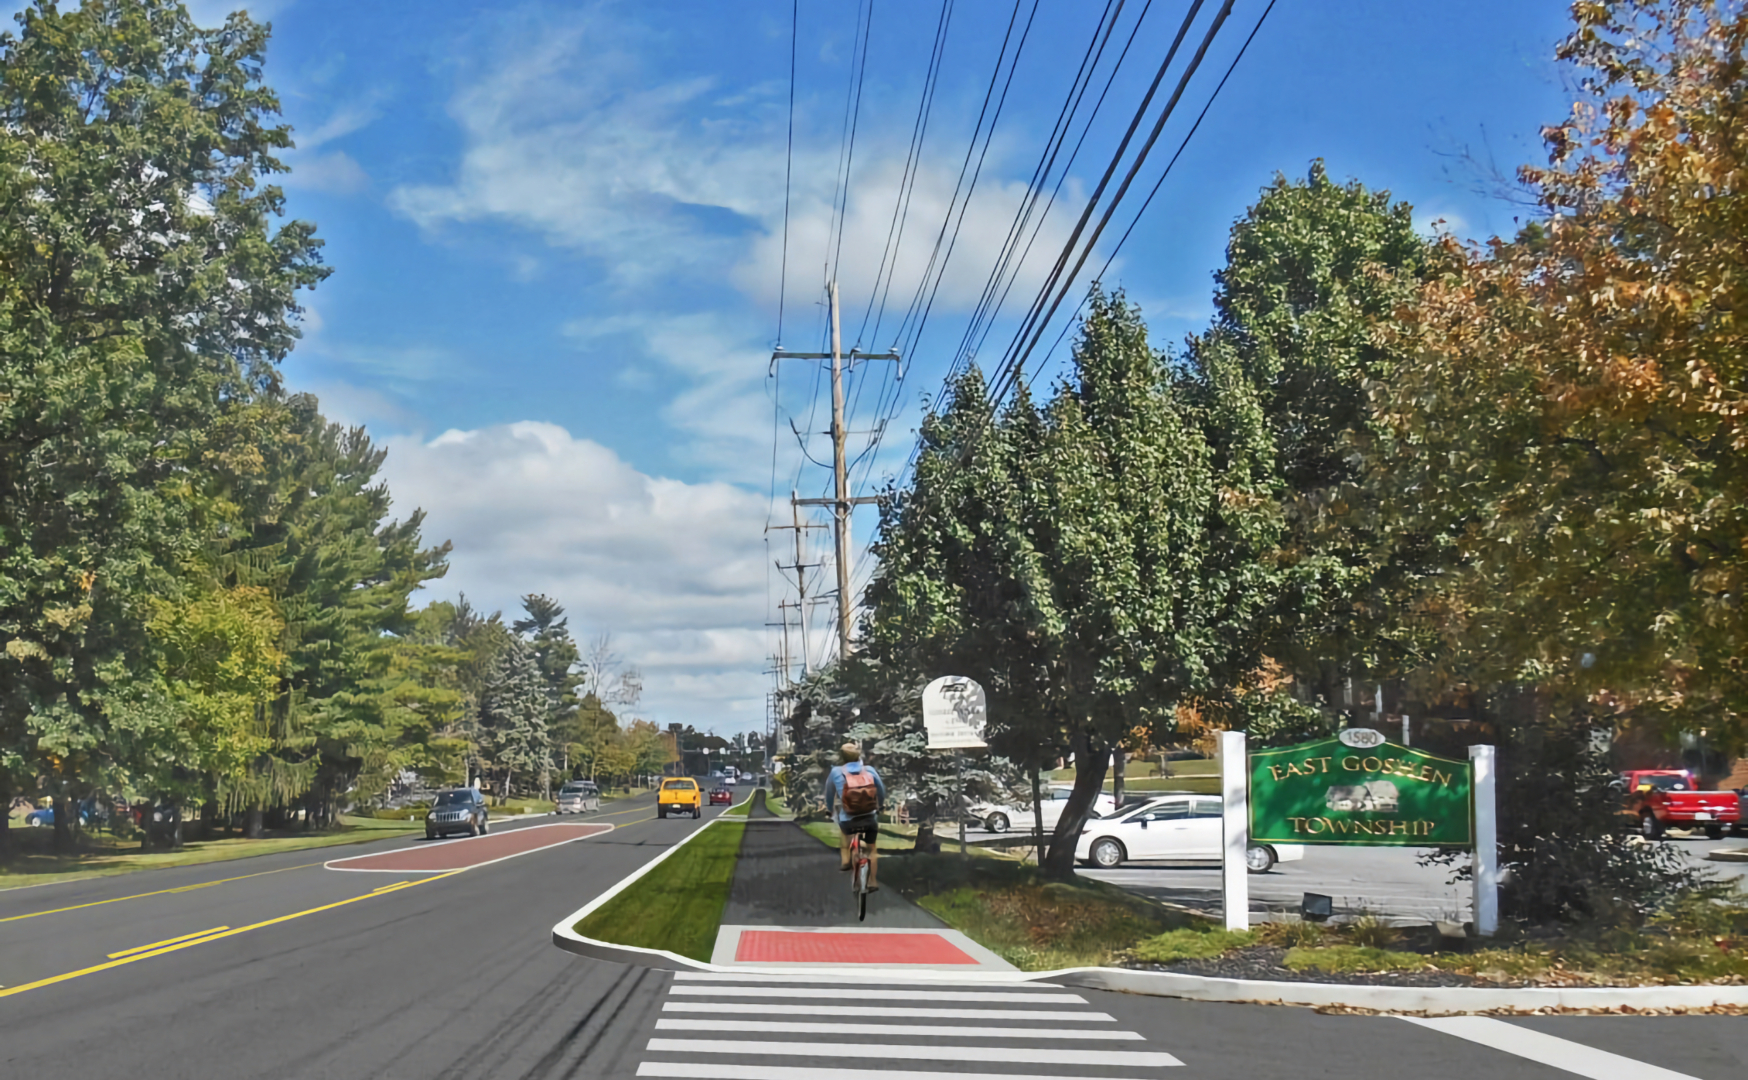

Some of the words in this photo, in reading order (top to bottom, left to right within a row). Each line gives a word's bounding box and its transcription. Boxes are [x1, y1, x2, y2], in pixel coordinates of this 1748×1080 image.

[1267, 756, 1332, 781] EAST
[1342, 755, 1452, 787] GOSHEN
[1286, 817, 1435, 835] TOWNSHIP
